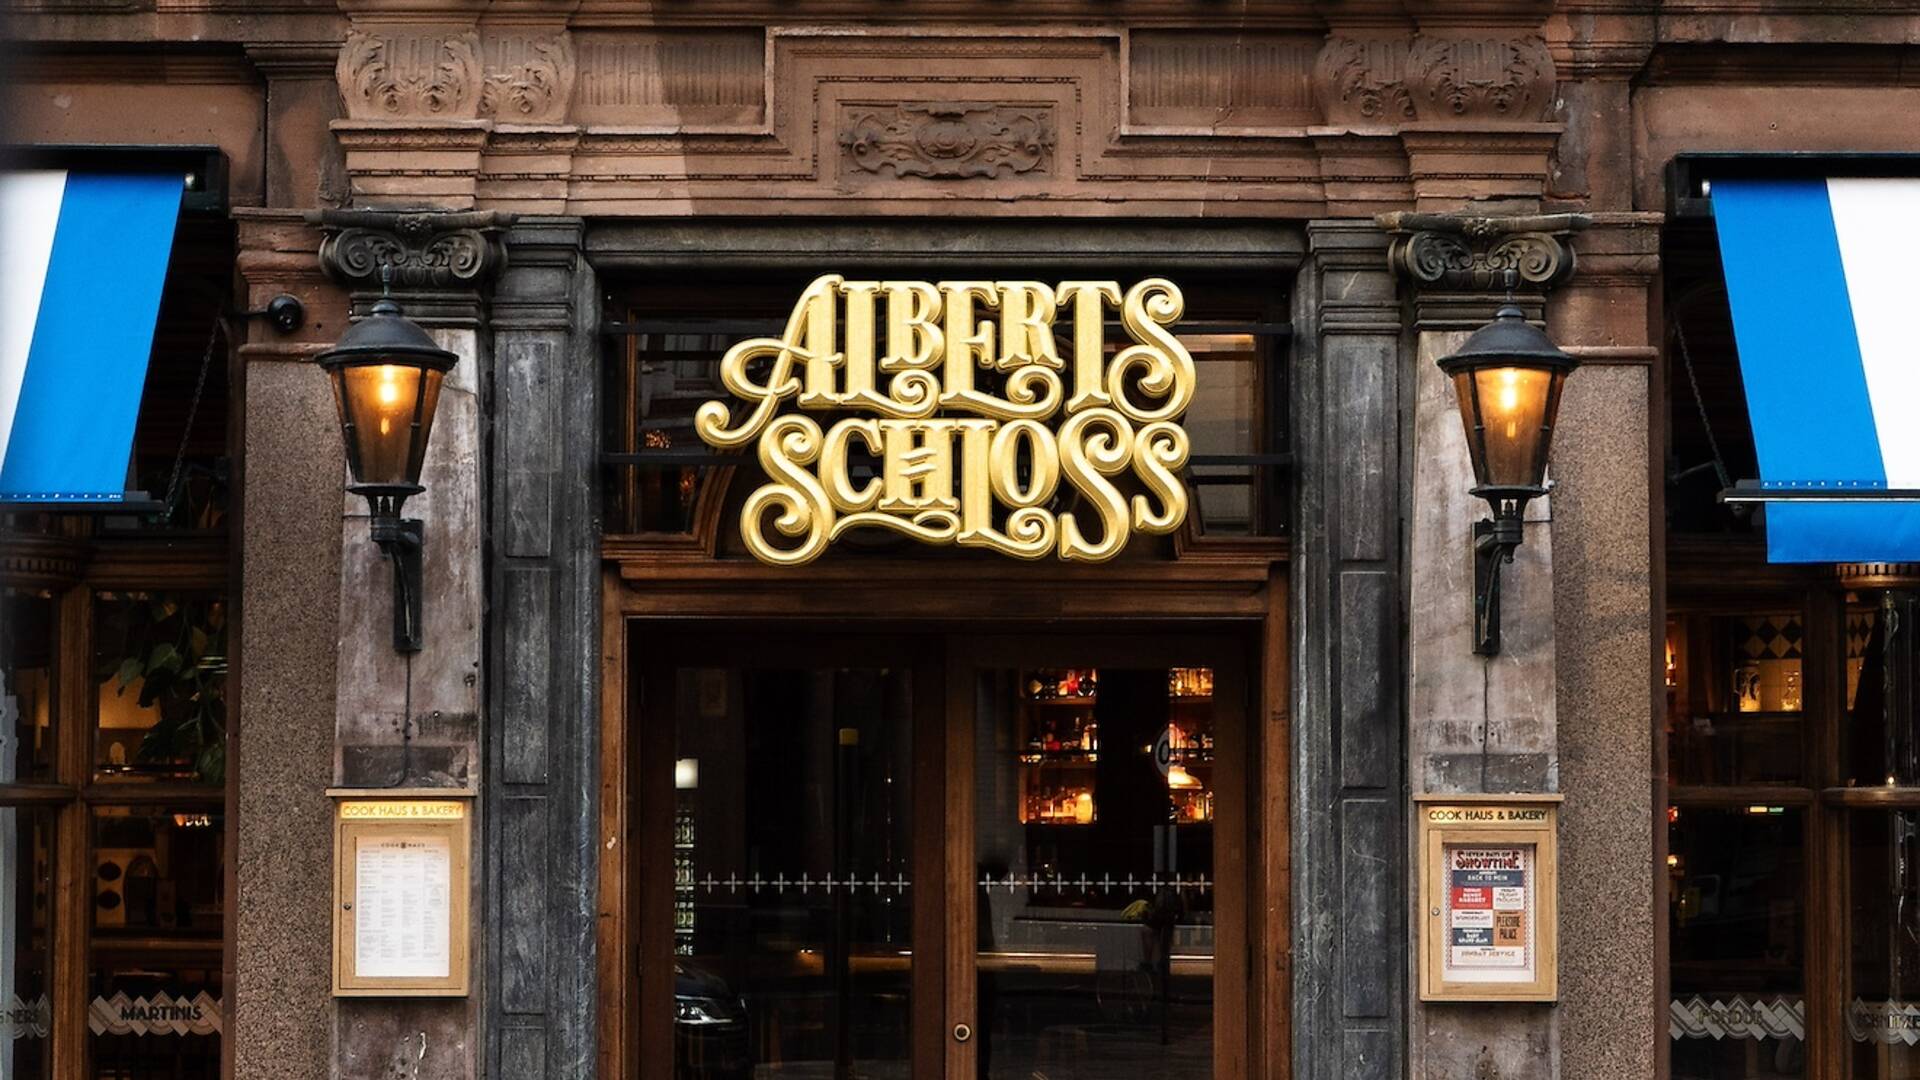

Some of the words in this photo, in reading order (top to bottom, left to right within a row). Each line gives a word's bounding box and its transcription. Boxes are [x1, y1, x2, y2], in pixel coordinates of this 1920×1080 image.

[695, 273, 1197, 447] ALBERTS
[740, 407, 1191, 566] SCHLOSS
[343, 805, 376, 816] COOK
[379, 805, 408, 816] HAUS
[411, 805, 419, 816] &
[422, 805, 461, 816] BAKERY
[1429, 810, 1462, 821] COOK
[1465, 810, 1494, 820] HAUS
[1497, 810, 1505, 820] &
[1508, 810, 1547, 820] BAKERY
[1456, 850, 1520, 870] SHOWTIME
[121, 1006, 203, 1021] MARTINIS
